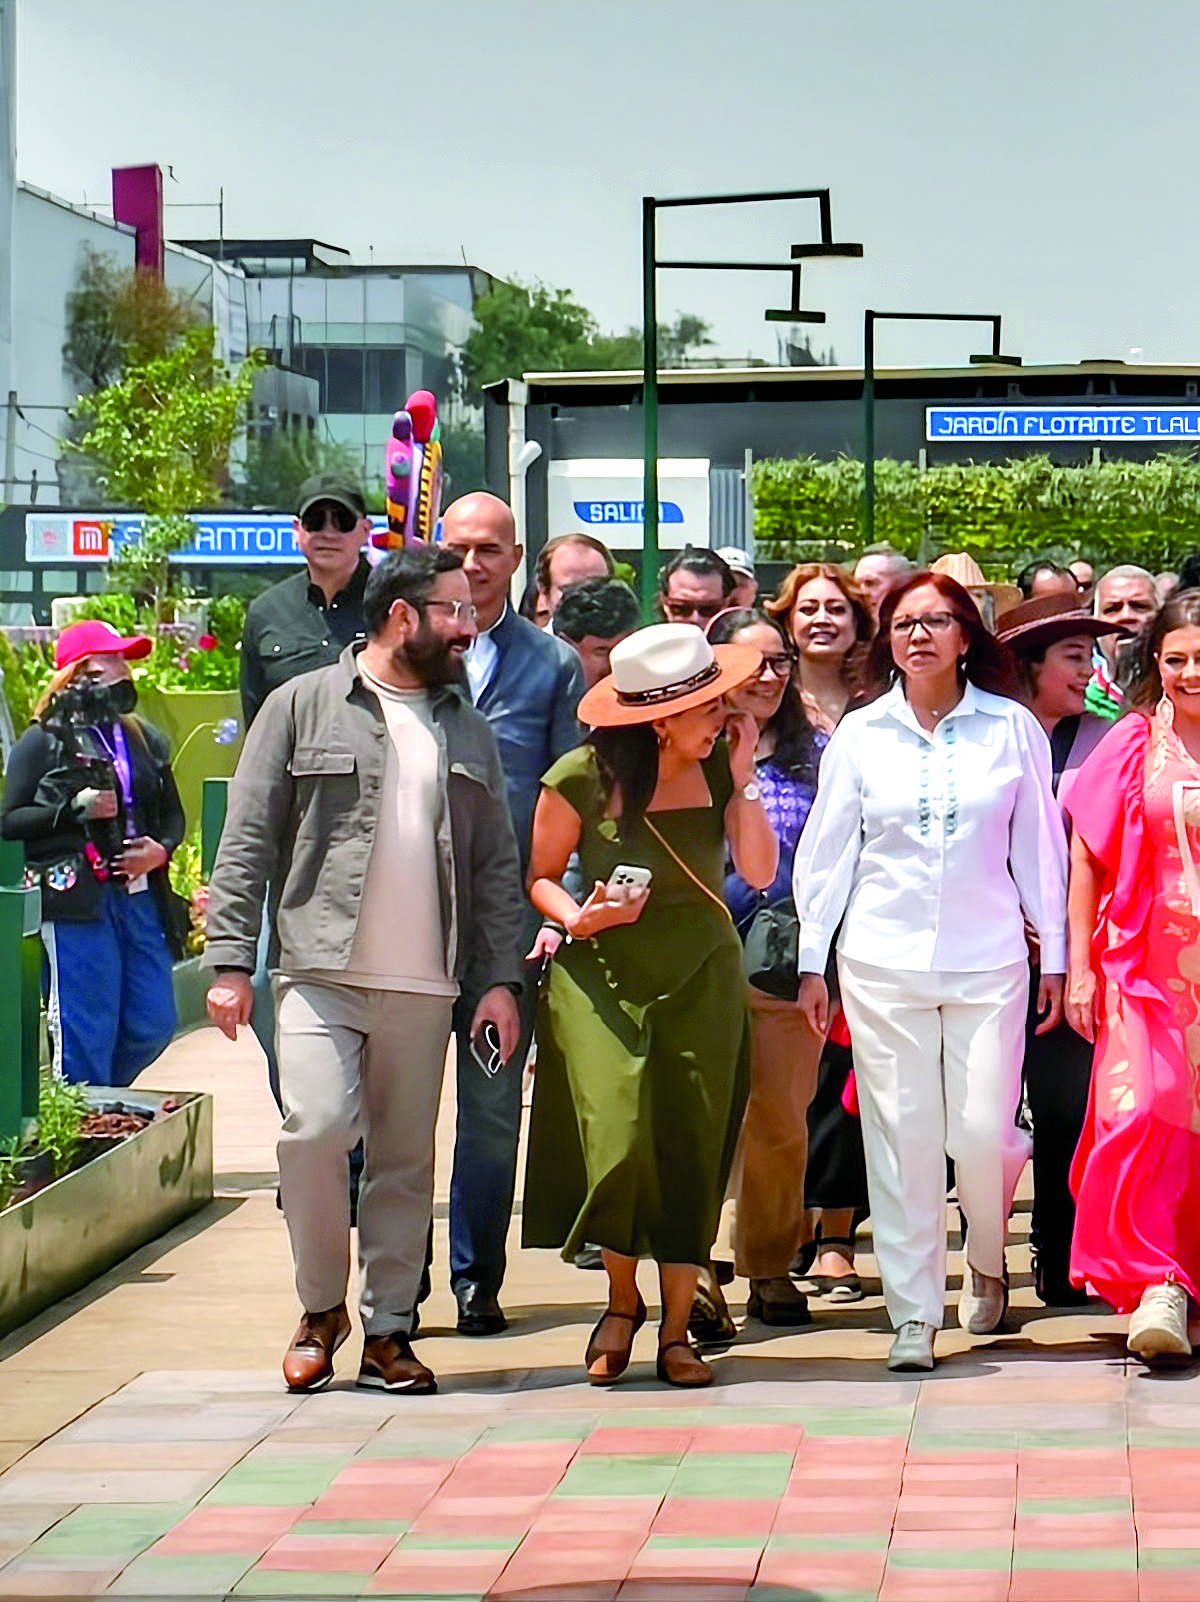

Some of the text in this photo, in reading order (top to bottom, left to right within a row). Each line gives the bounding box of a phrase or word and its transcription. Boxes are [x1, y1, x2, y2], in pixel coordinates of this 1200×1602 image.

[938, 410, 1019, 434] JARDÍN
[1024, 416, 1136, 434] FLOTANTE
[195, 527, 297, 551] ANTON
